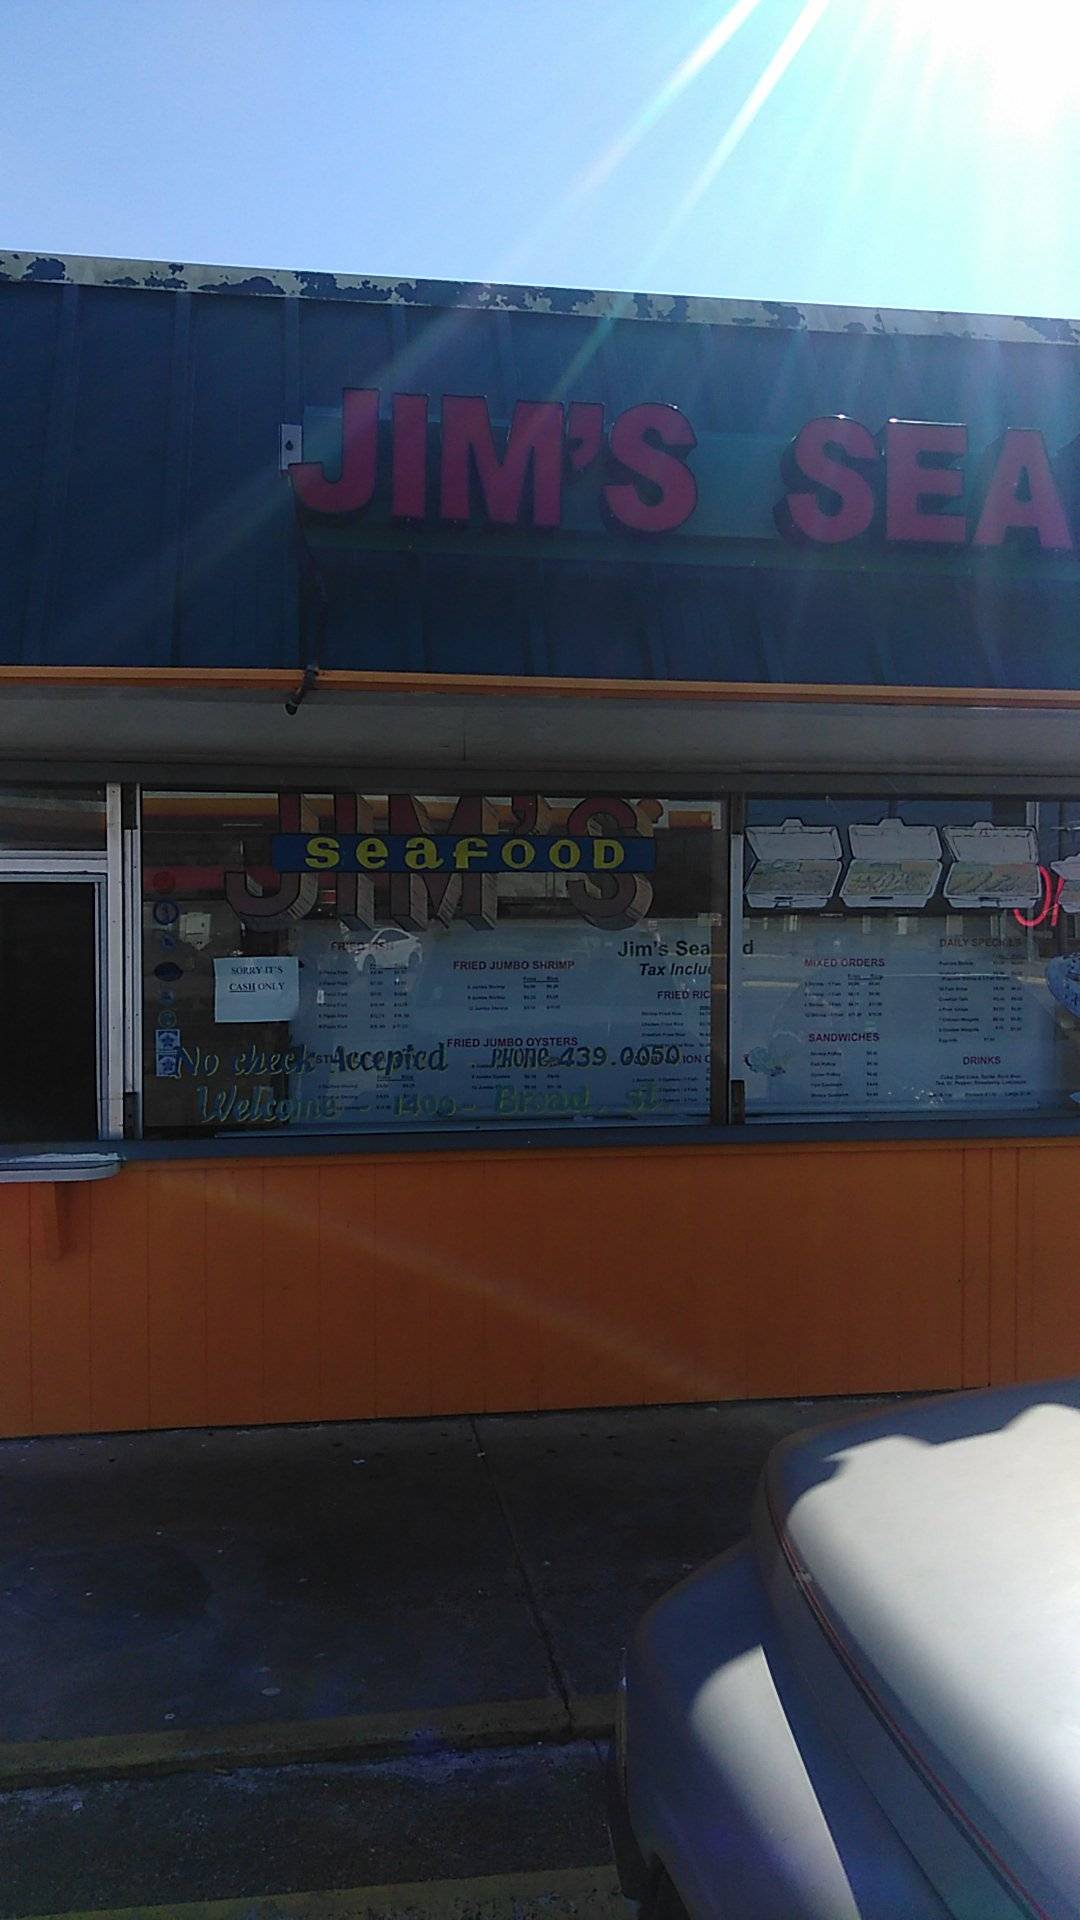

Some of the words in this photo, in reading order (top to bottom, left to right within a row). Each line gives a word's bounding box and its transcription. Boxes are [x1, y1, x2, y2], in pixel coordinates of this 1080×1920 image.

[288, 387, 697, 533] JIM'S
[940, 938, 969, 947] DAILY
[618, 941, 669, 957] Jim's
[453, 961, 487, 970] FRIED
[490, 961, 529, 970] JUMBO
[532, 961, 575, 970] SHRIMP
[804, 959, 837, 968] MIXED
[841, 958, 885, 967] ORDERS
[231, 966, 261, 975] SORRY
[640, 963, 666, 976] Tax
[229, 982, 256, 992] CASH
[257, 982, 285, 991] ONLY
[657, 990, 689, 1000] FRIED
[447, 1039, 480, 1048] FRIED
[483, 1038, 523, 1047] JUMBO
[526, 1037, 578, 1047] OYSTERS
[808, 1033, 880, 1042] SANDWICHES
[178, 1046, 221, 1078] No
[962, 1056, 1001, 1065] DRINKS
[196, 1084, 336, 1123] Welcome
